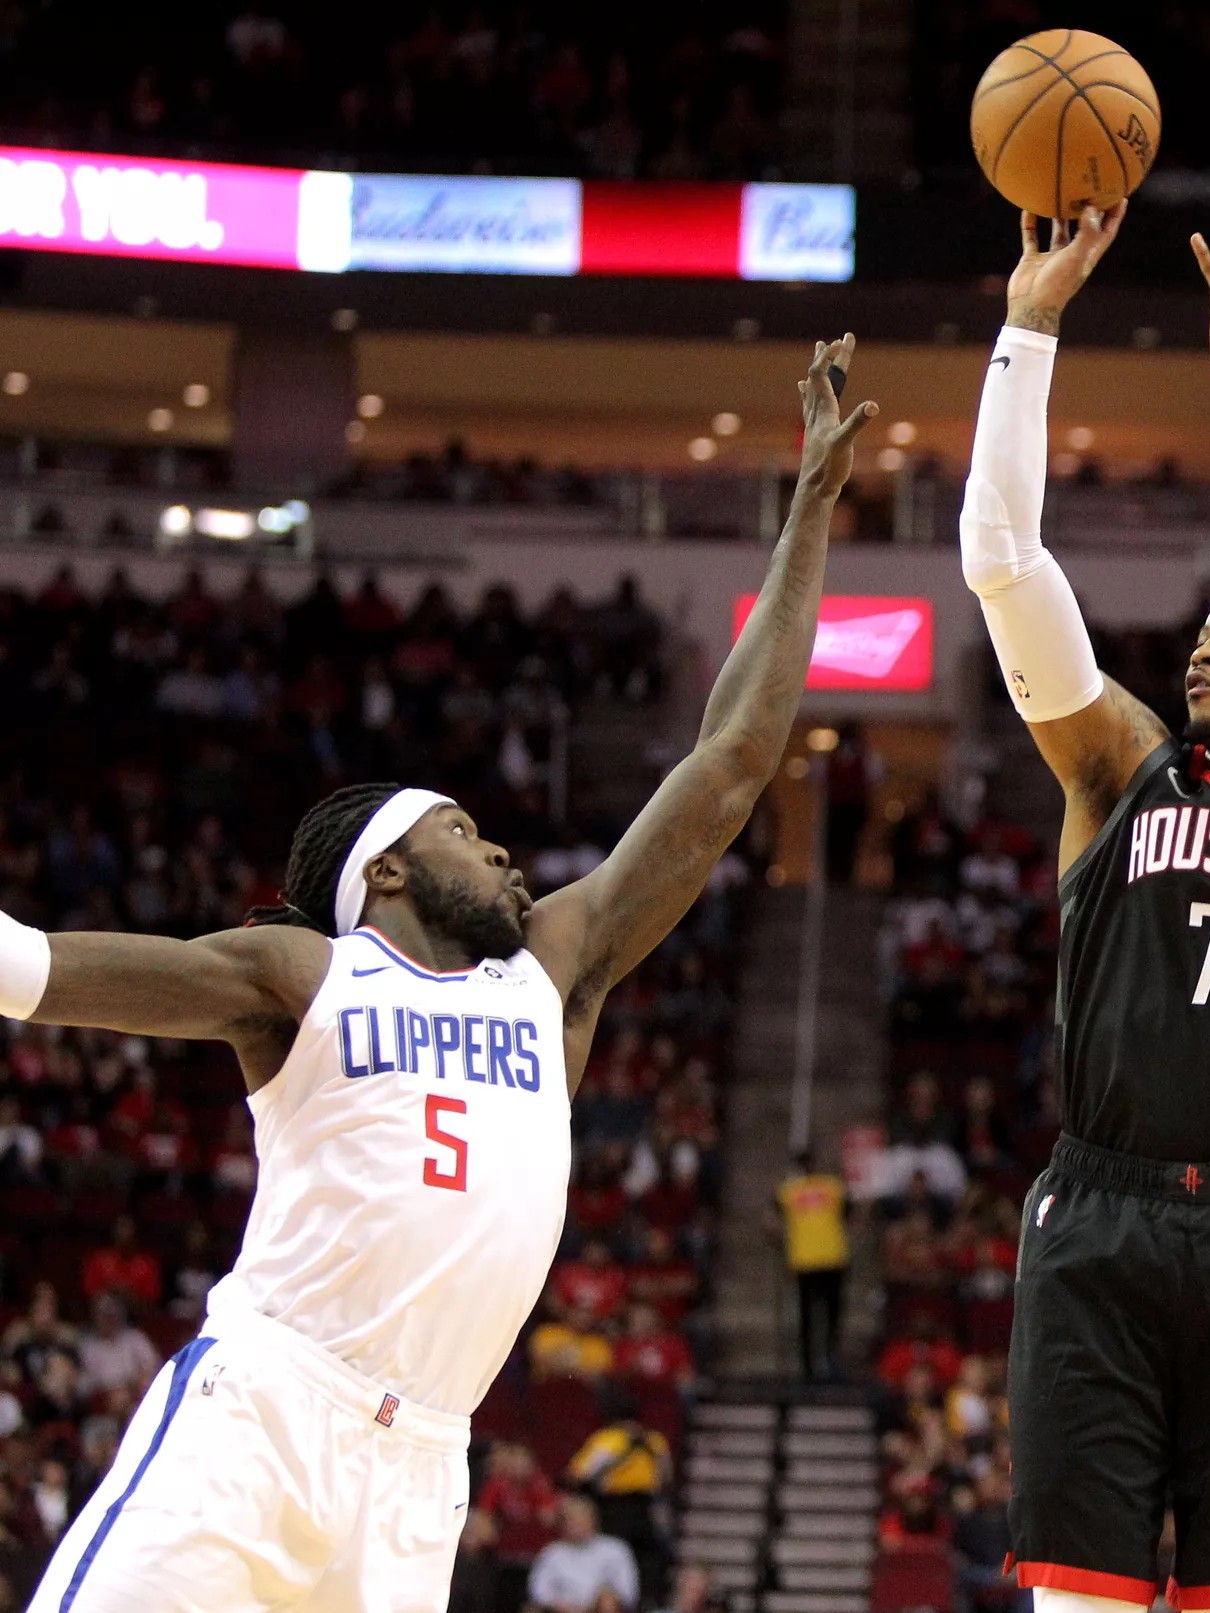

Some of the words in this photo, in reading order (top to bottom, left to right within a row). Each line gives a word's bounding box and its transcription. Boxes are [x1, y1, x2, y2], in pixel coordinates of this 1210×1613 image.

[72, 165, 225, 251] YOU.
[337, 1005, 541, 1094] CLIPPERS
[423, 1093, 468, 1192] 5
